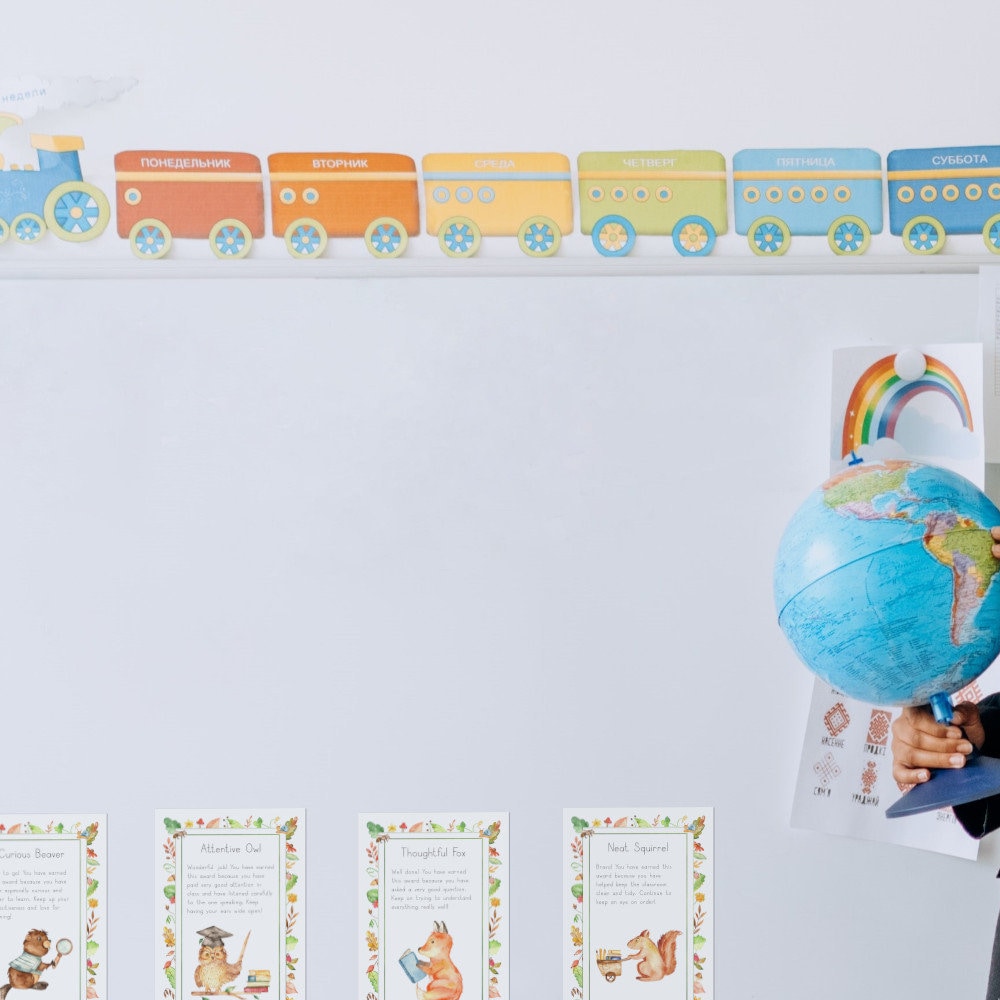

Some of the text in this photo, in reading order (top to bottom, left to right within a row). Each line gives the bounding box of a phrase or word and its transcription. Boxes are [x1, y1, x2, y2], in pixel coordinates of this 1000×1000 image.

[2, 88, 47, 103] недели
[140, 158, 231, 170] ПОНЕДЕЛЬНИК
[312, 158, 369, 169] ВТОРНИК
[474, 158, 516, 169] СРЕДА
[623, 157, 679, 169] ЧЕТВЕРГ
[776, 156, 836, 168] ПЯТНИЦА
[931, 153, 988, 166] СУББОТА
